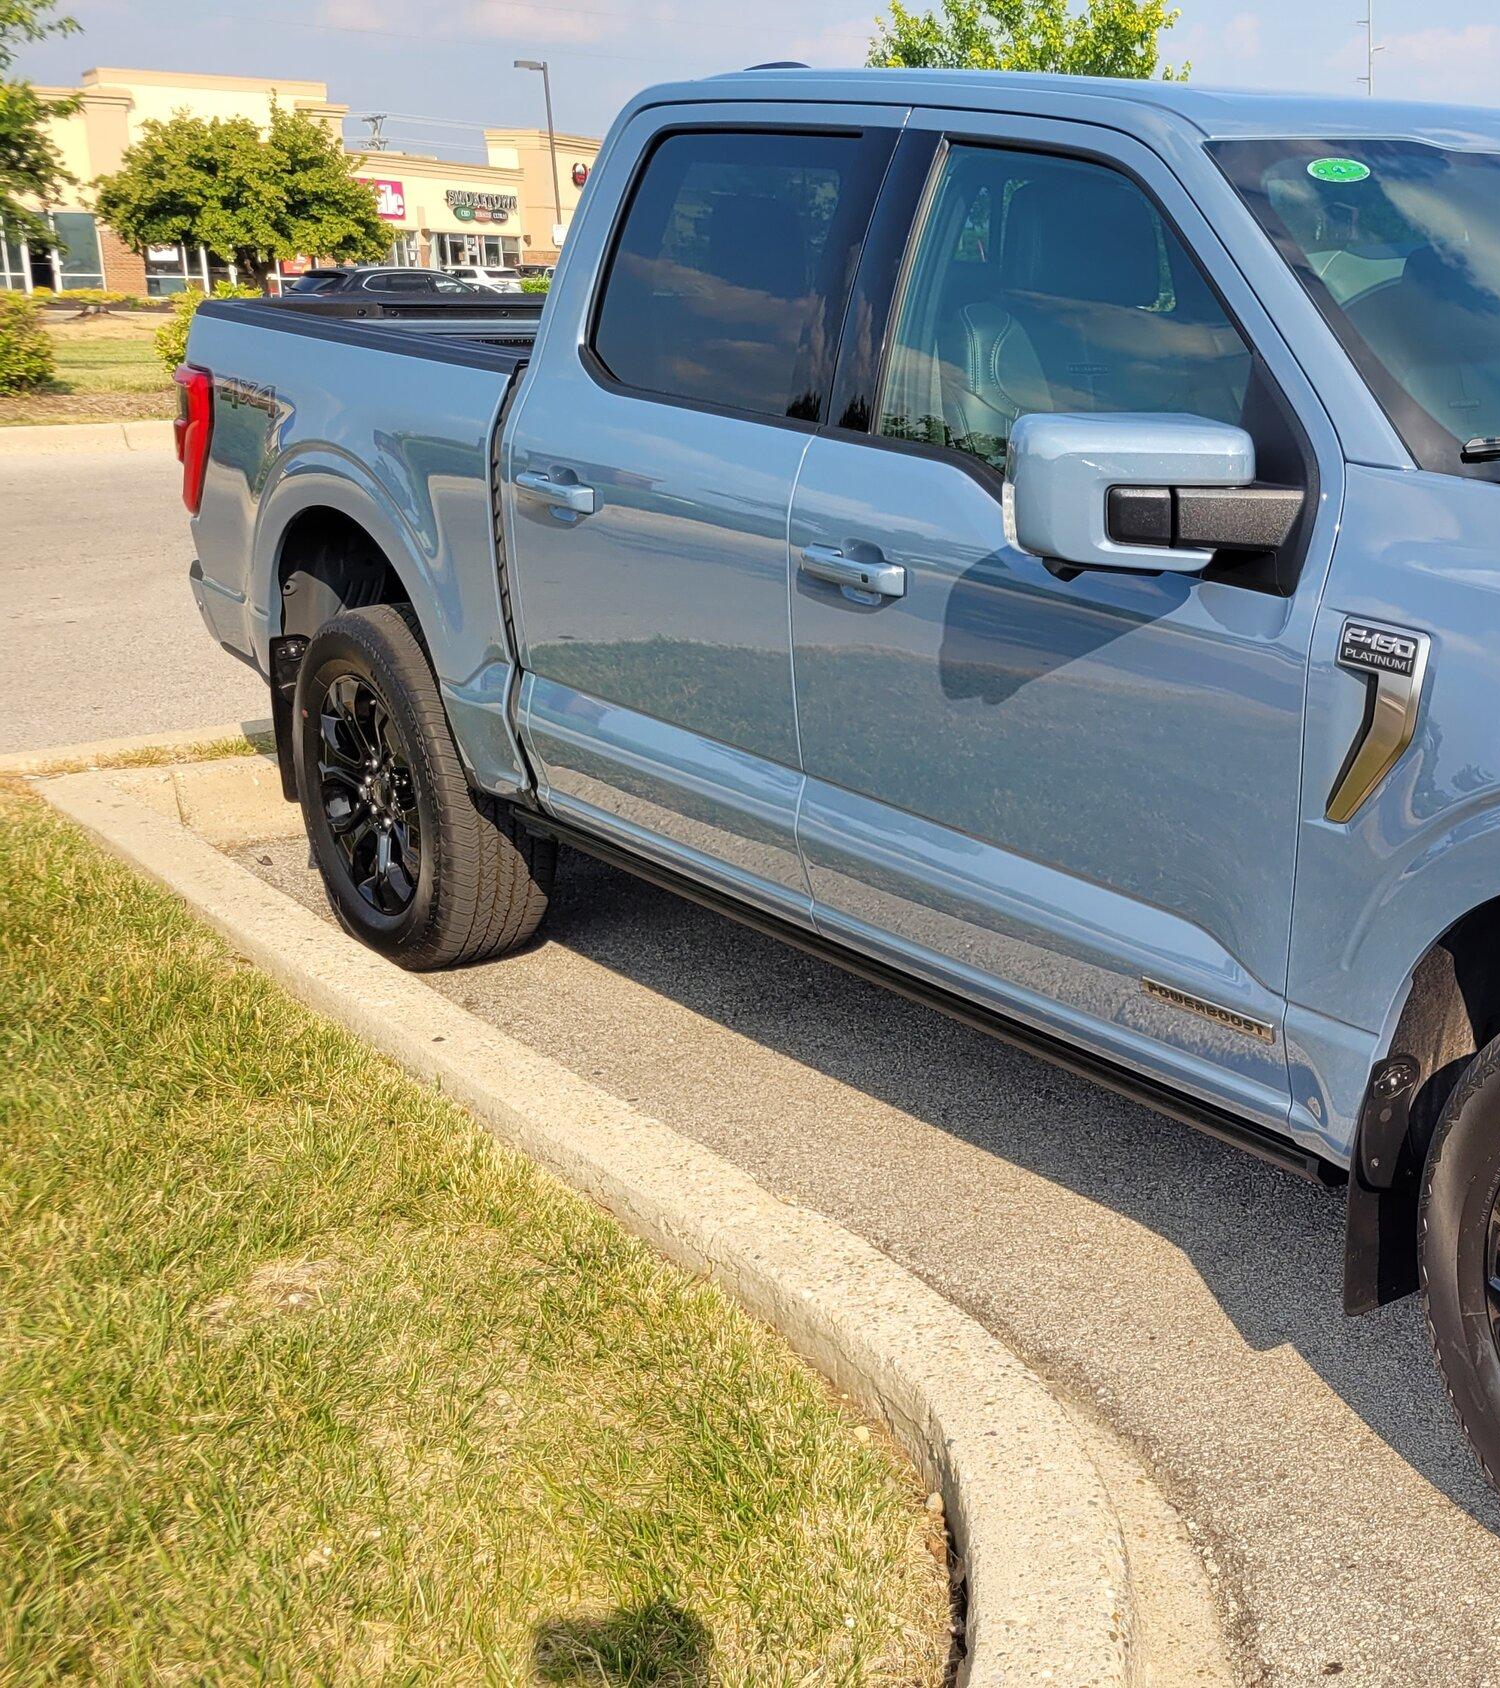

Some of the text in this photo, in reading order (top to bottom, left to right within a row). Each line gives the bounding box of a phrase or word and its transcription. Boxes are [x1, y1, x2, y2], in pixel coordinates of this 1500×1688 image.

[1343, 627, 1416, 659] F-150
[1345, 647, 1407, 671] PLATINUM
[1148, 982, 1265, 1036] POWERBOOST
